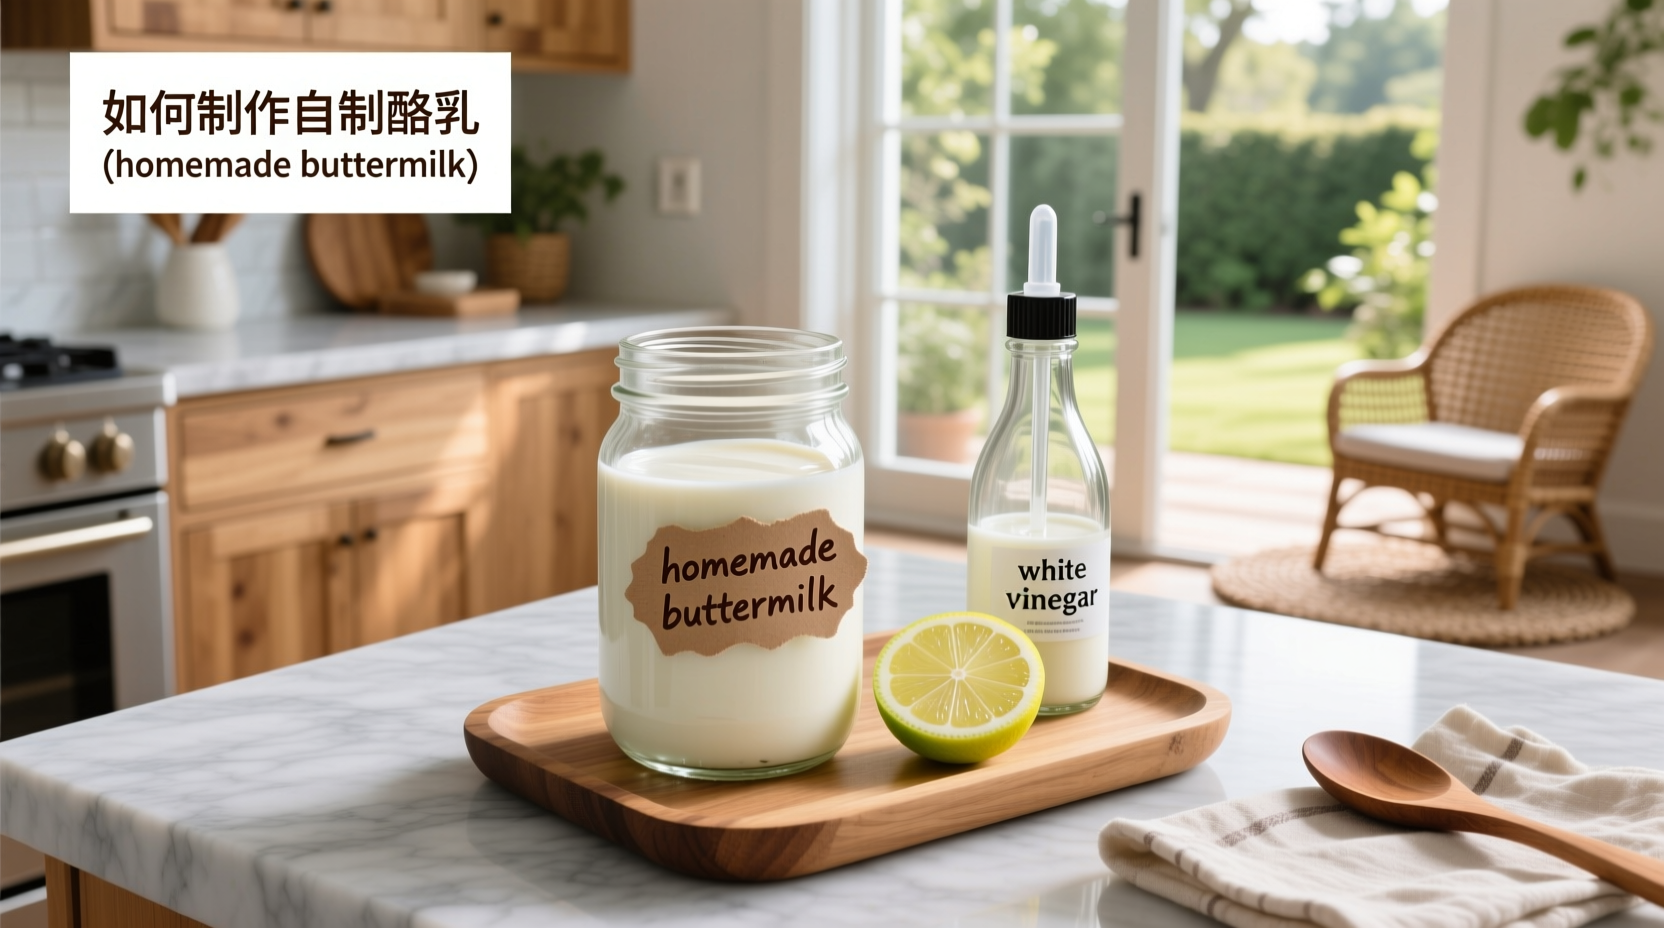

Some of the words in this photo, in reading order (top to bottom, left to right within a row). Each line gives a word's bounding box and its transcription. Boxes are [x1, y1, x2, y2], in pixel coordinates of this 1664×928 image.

[662, 527, 837, 584] homemade
[1018, 558, 1087, 581] white
[662, 575, 838, 630] buttermilk
[1006, 587, 1098, 616] vinegar
